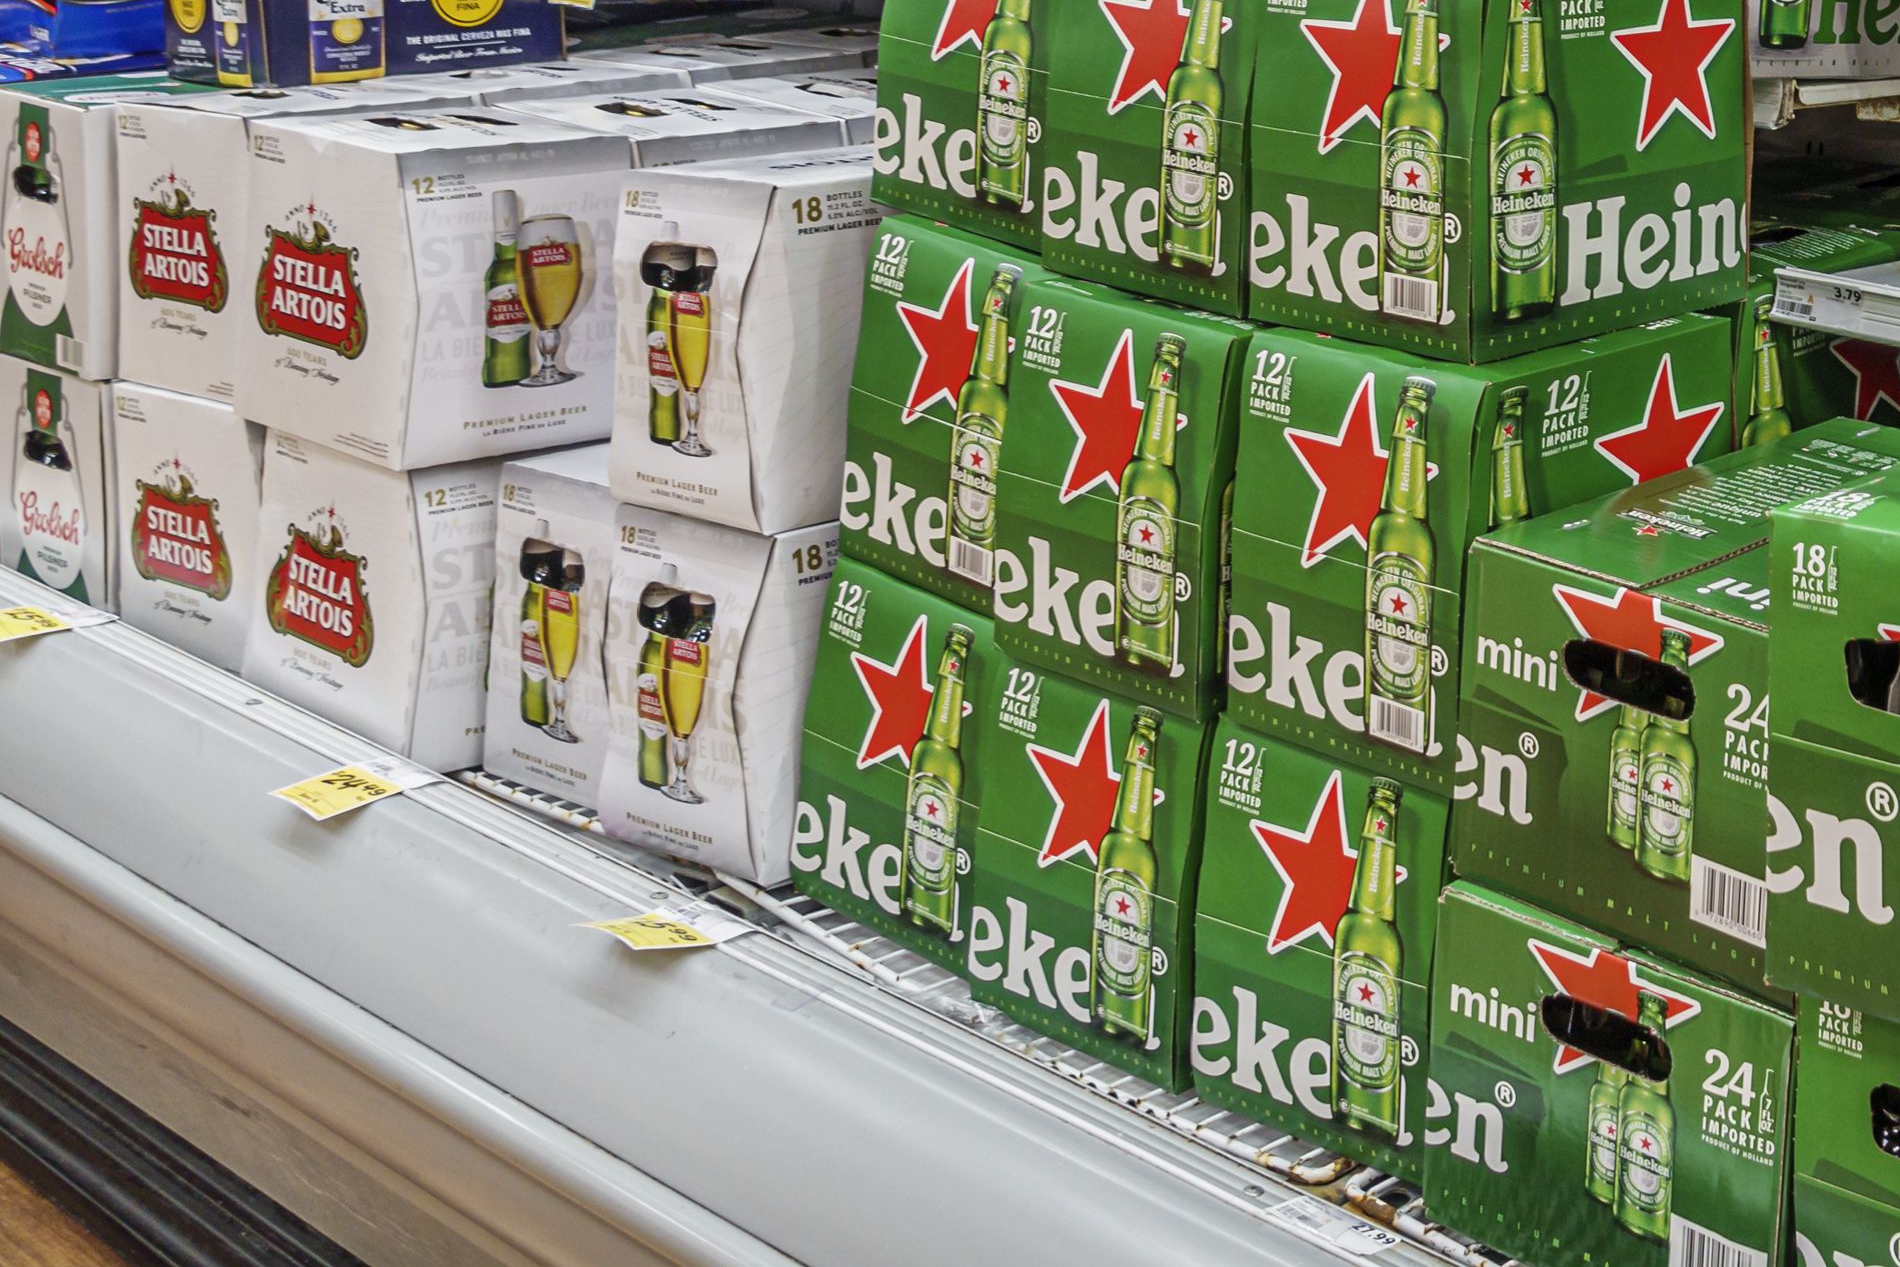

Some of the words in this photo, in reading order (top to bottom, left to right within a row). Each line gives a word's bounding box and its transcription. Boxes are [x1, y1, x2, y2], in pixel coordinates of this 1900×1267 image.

[425, 32, 459, 45] ORIGINAL
[460, 31, 496, 43] CERVEZA
[1560, 15, 1606, 33] IMPORTED
[791, 195, 823, 224] 18
[826, 190, 863, 203] BOTTLES
[1492, 191, 1555, 215] Heineken
[9, 227, 65, 283] Grolsch
[273, 252, 345, 299] STELLA
[271, 284, 346, 331] ARTOIS
[463, 418, 517, 432] PREMIUM
[519, 412, 558, 426] LAGER
[560, 406, 588, 419] BEER
[147, 506, 210, 545] STELLA
[147, 534, 213, 576] ARTOIS
[1792, 542, 1825, 576] 18
[1791, 591, 1839, 609] IMPORTED
[1476, 636, 1558, 692] mini
[1450, 982, 1536, 1044] mini
[1702, 1048, 1756, 1107] 24
[1702, 1095, 1751, 1130] PACK
[1701, 1116, 1775, 1154] IMPORTED
